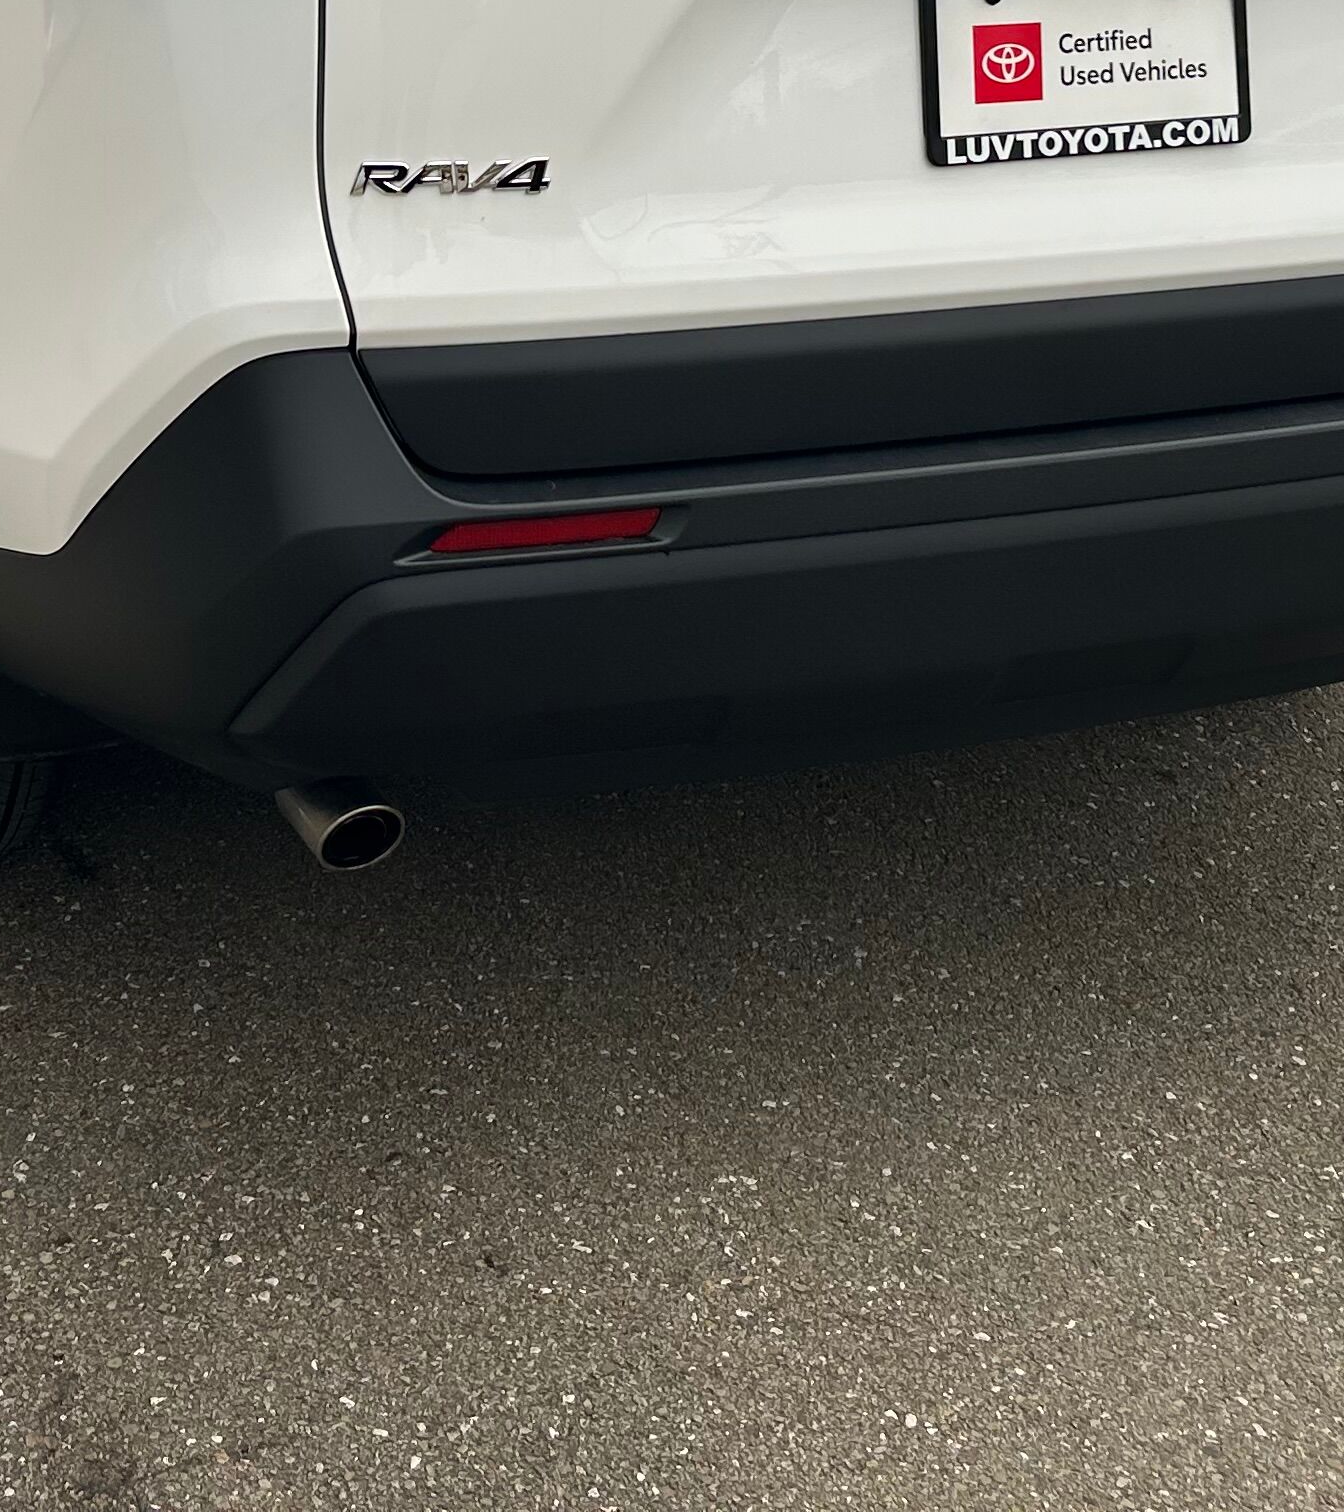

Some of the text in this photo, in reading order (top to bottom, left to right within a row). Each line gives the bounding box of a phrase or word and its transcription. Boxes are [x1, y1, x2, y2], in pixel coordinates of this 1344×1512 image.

[1059, 28, 1152, 54] Certified
[1060, 58, 1207, 86] Used Vehicles
[946, 117, 1239, 165] LUVTOYOTA.COM
[350, 156, 551, 196] RAV4
